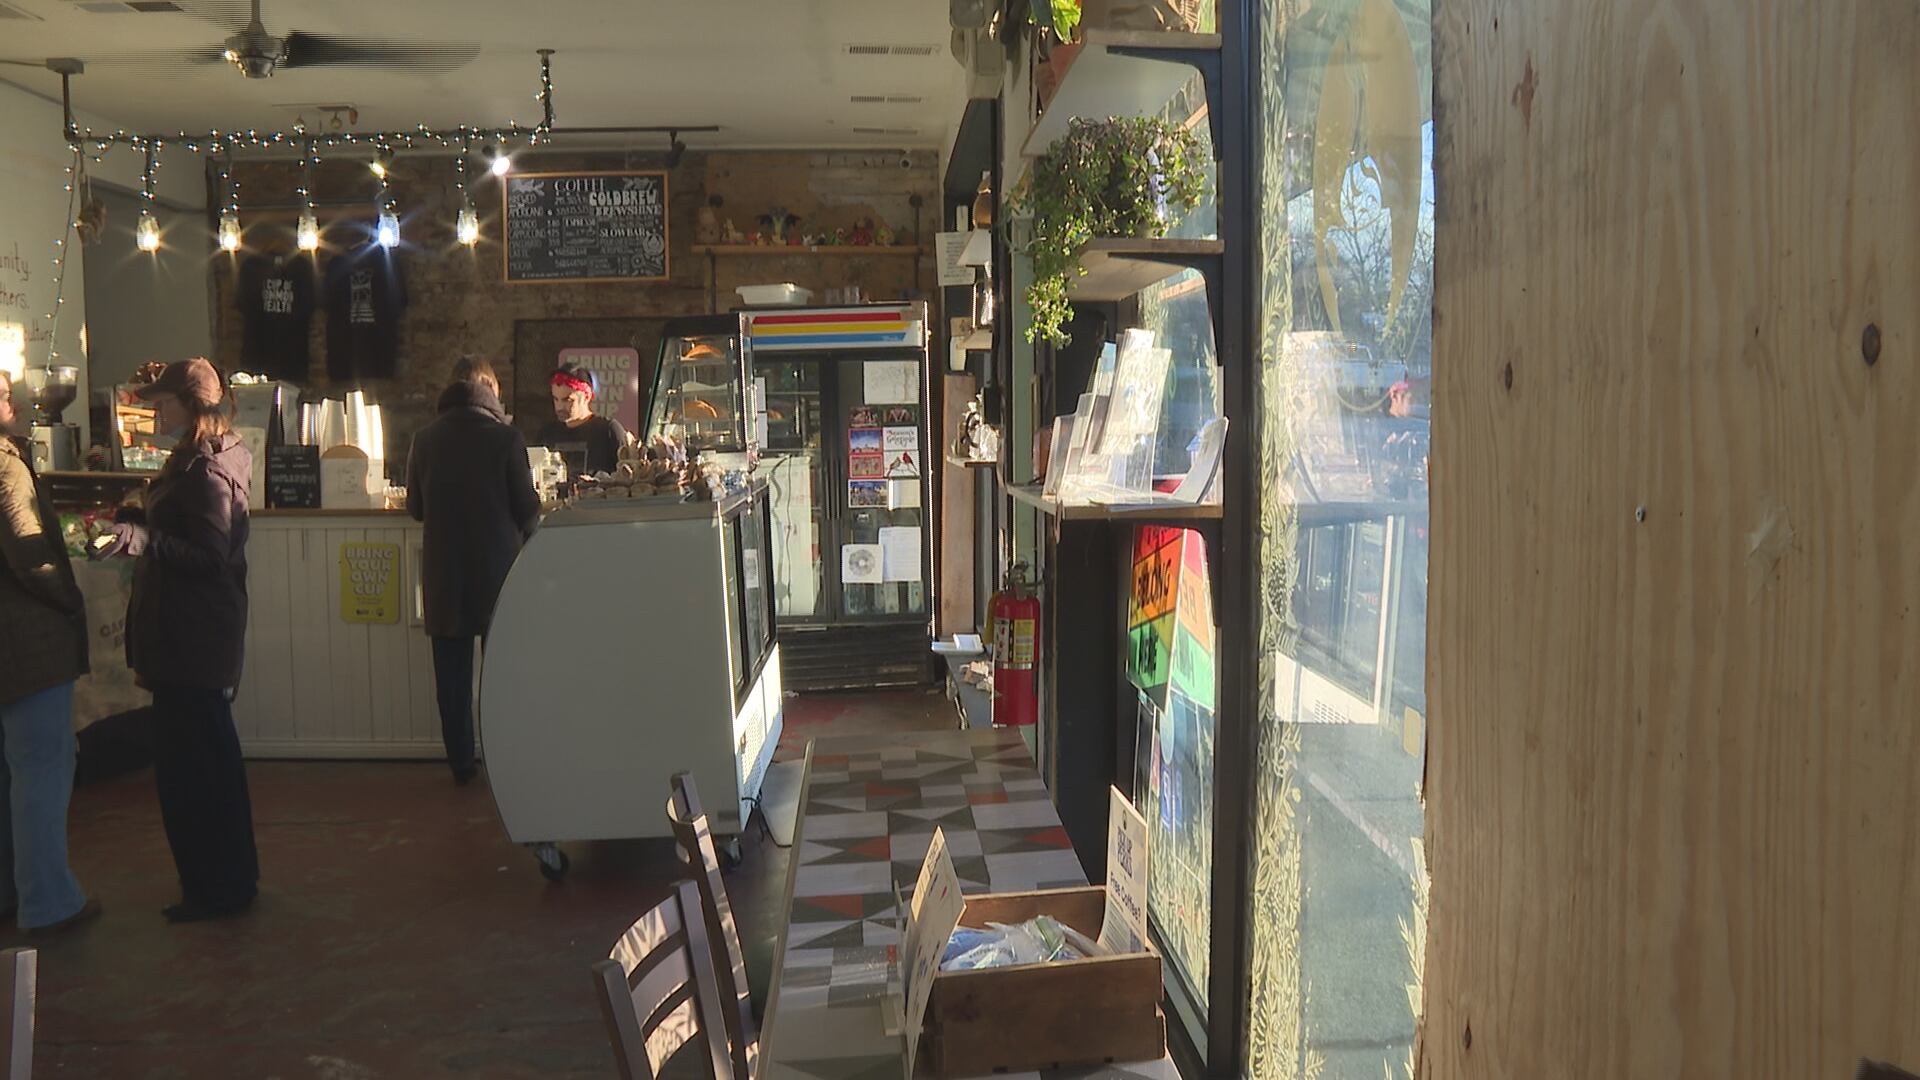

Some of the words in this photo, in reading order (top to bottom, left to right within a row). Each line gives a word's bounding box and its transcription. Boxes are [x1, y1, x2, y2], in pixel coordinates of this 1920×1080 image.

[589, 189, 657, 206] COLDBREW
[595, 204, 662, 217] BREWSHINE
[599, 228, 625, 238] SLOW
[346, 547, 393, 560] BRING
[350, 559, 391, 572] YOUR
[351, 571, 388, 584] OWN
[353, 583, 384, 596] CUP
[1110, 871, 1121, 896] Free
